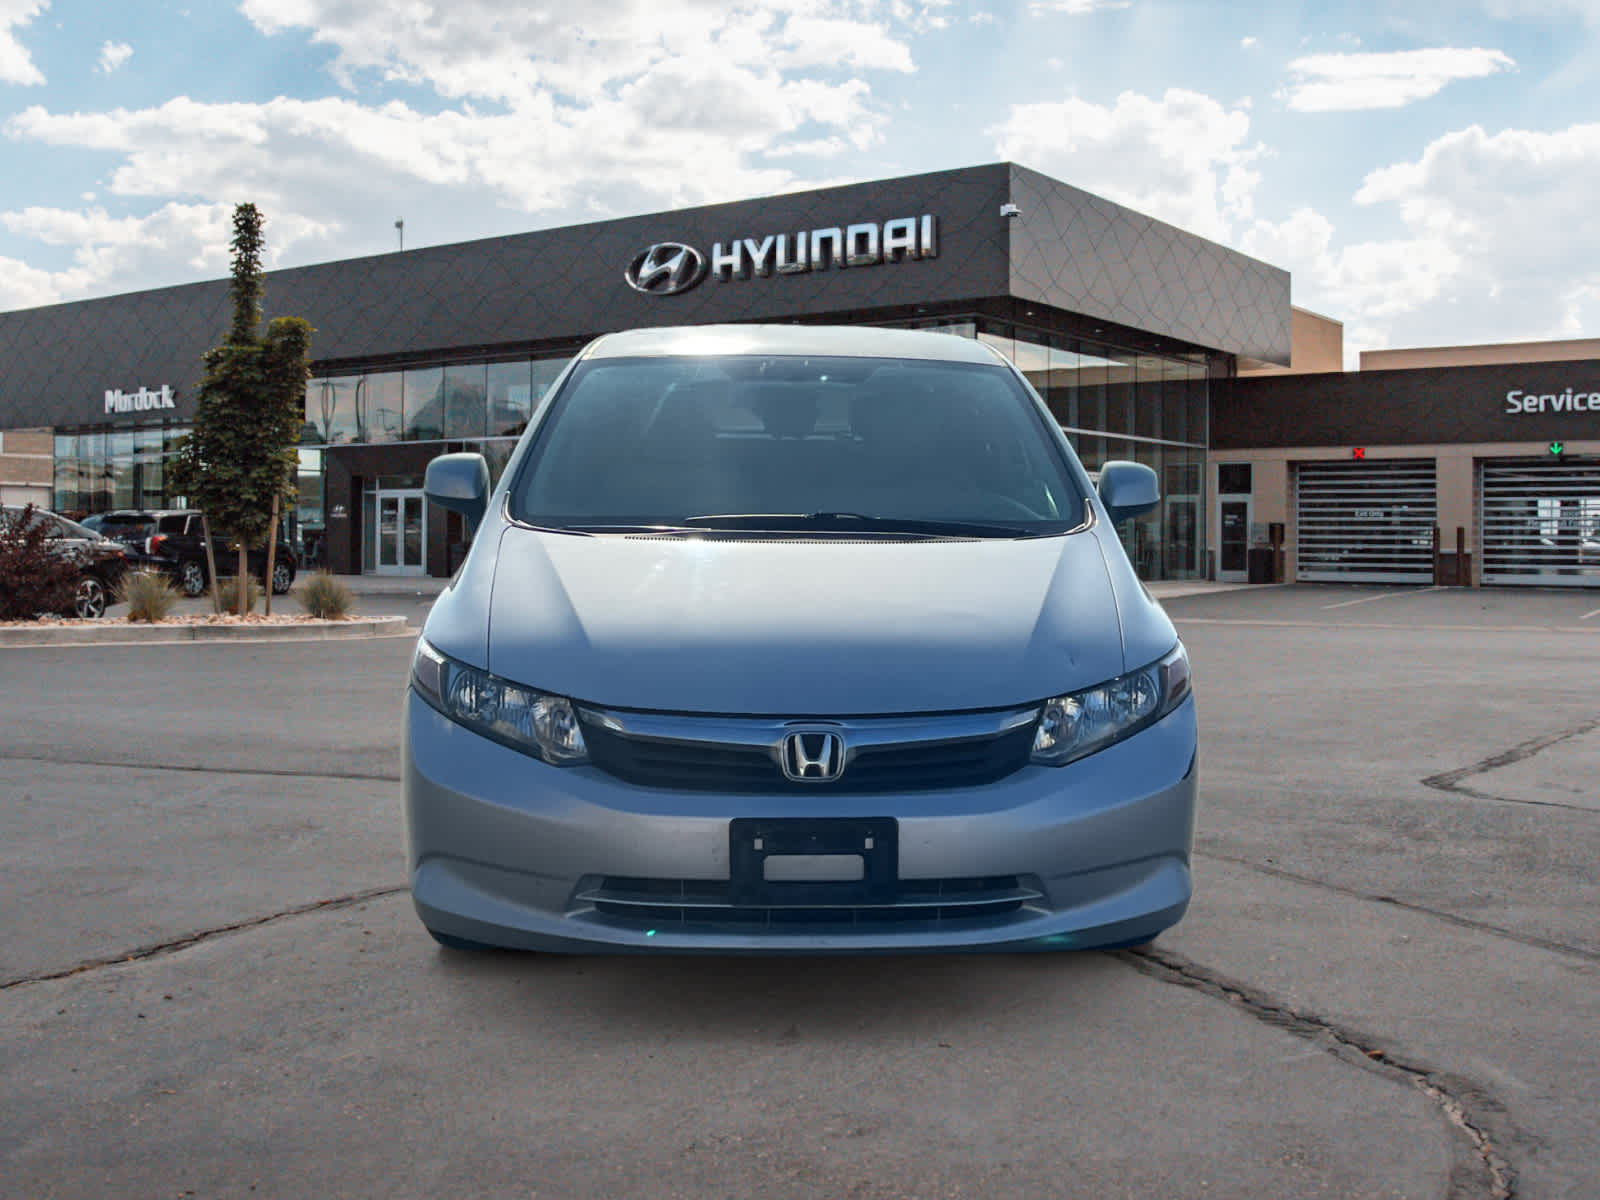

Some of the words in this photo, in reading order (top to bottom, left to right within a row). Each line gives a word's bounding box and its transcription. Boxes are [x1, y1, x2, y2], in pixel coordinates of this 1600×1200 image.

[712, 214, 937, 281] HYUNDAI
[104, 385, 176, 413] Murdock
[1505, 388, 1600, 413] Service
